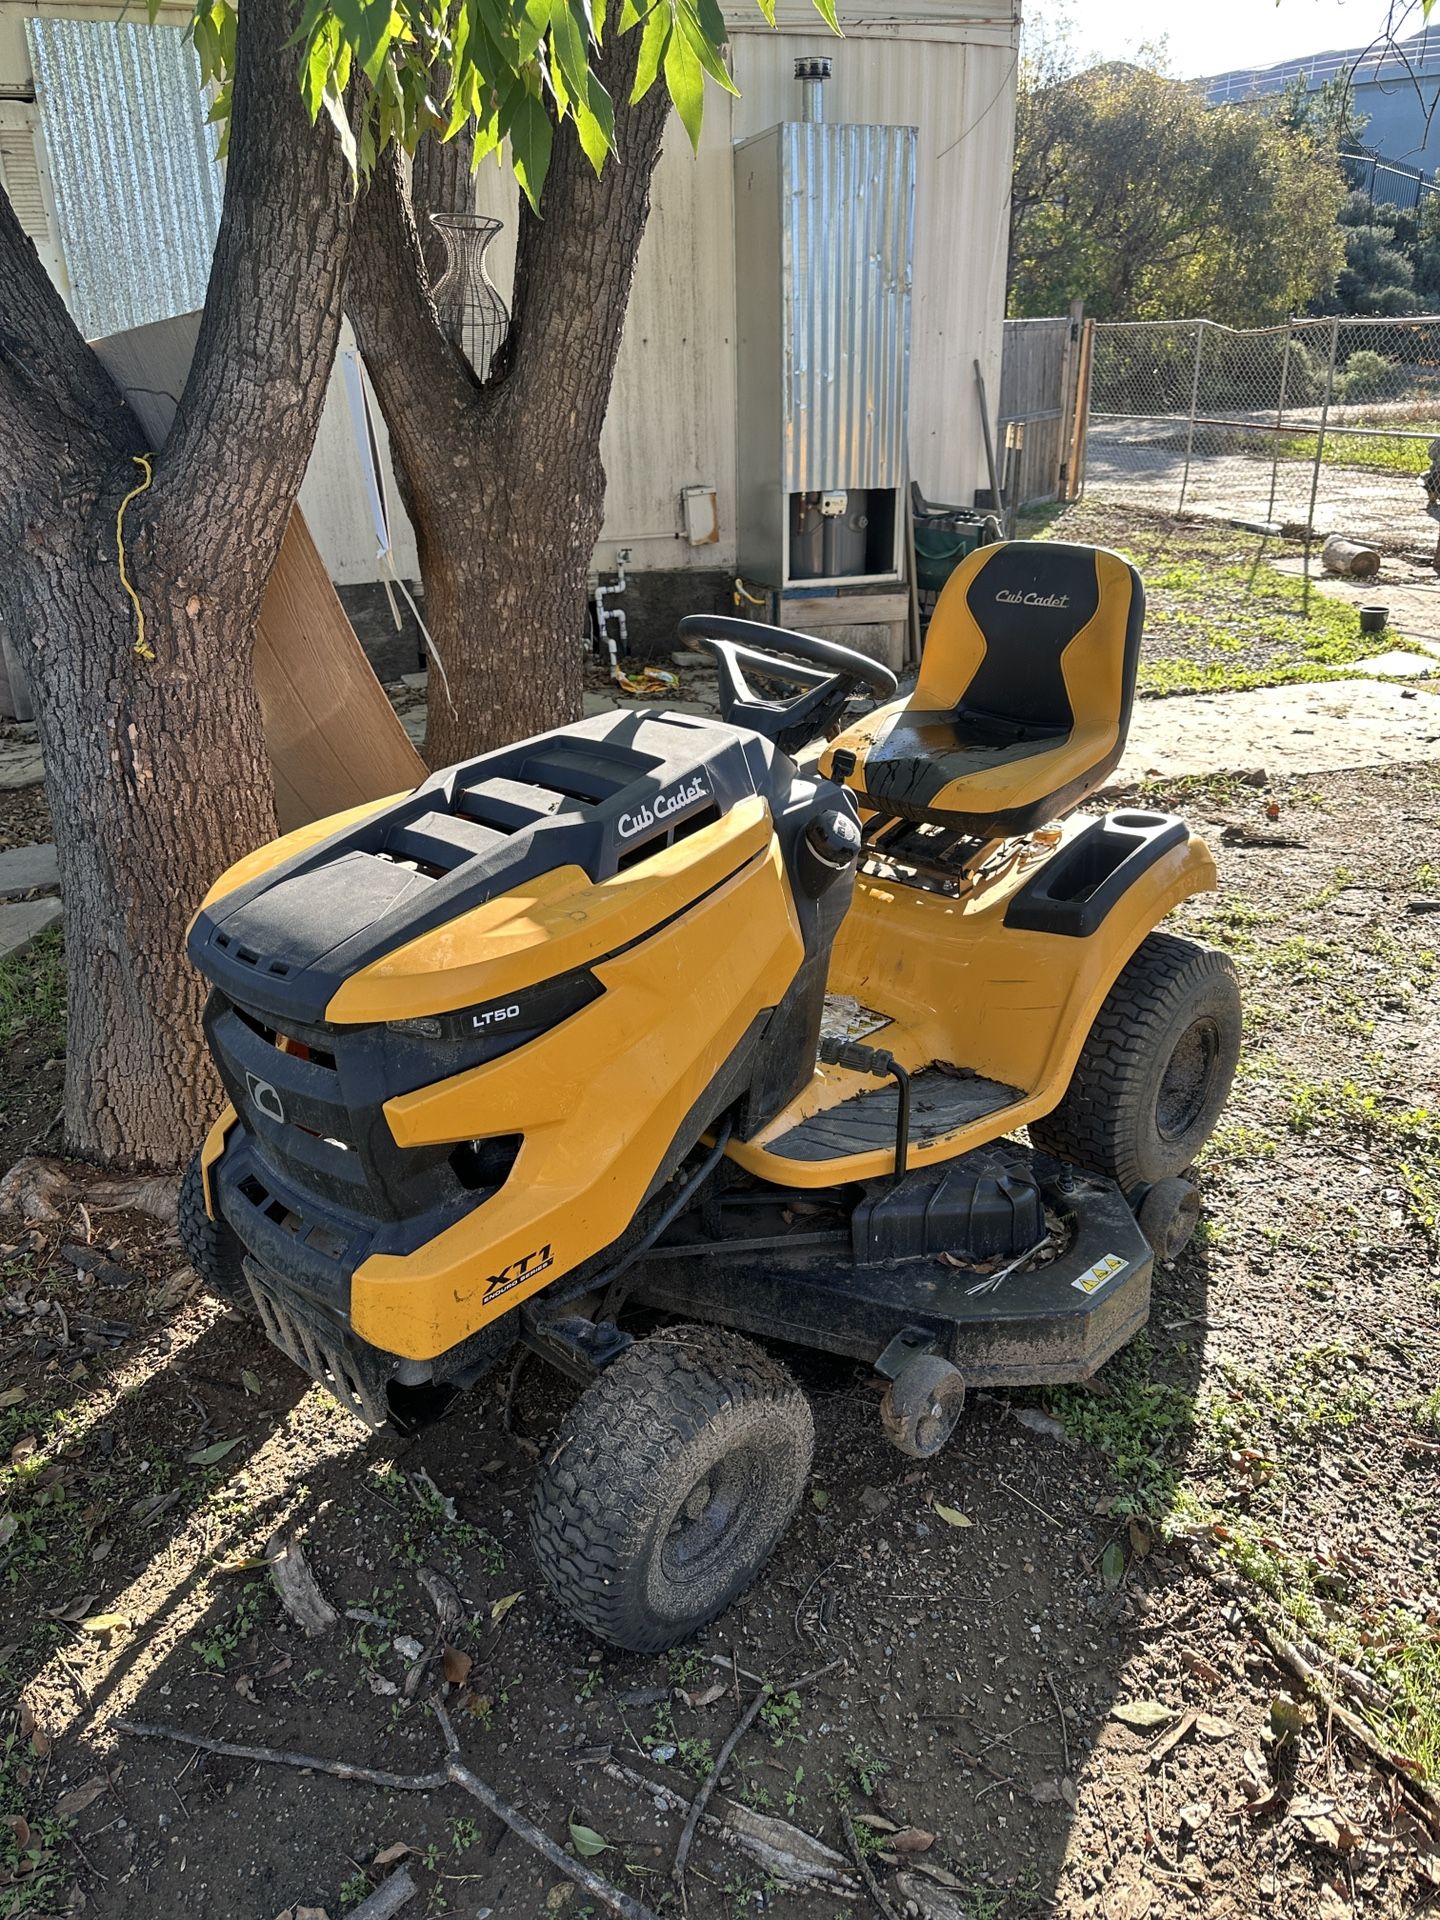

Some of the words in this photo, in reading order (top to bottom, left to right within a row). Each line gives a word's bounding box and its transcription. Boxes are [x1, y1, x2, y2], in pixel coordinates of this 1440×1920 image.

[995, 589, 1023, 604] Cub
[1023, 592, 1070, 609] Cadet
[617, 804, 655, 838] Cub
[653, 777, 708, 819] Cadet
[472, 1004, 520, 1028] LT50
[483, 1243, 552, 1296] XT1
[483, 1279, 518, 1303] ENDURO
[519, 1261, 549, 1282] SERIES
